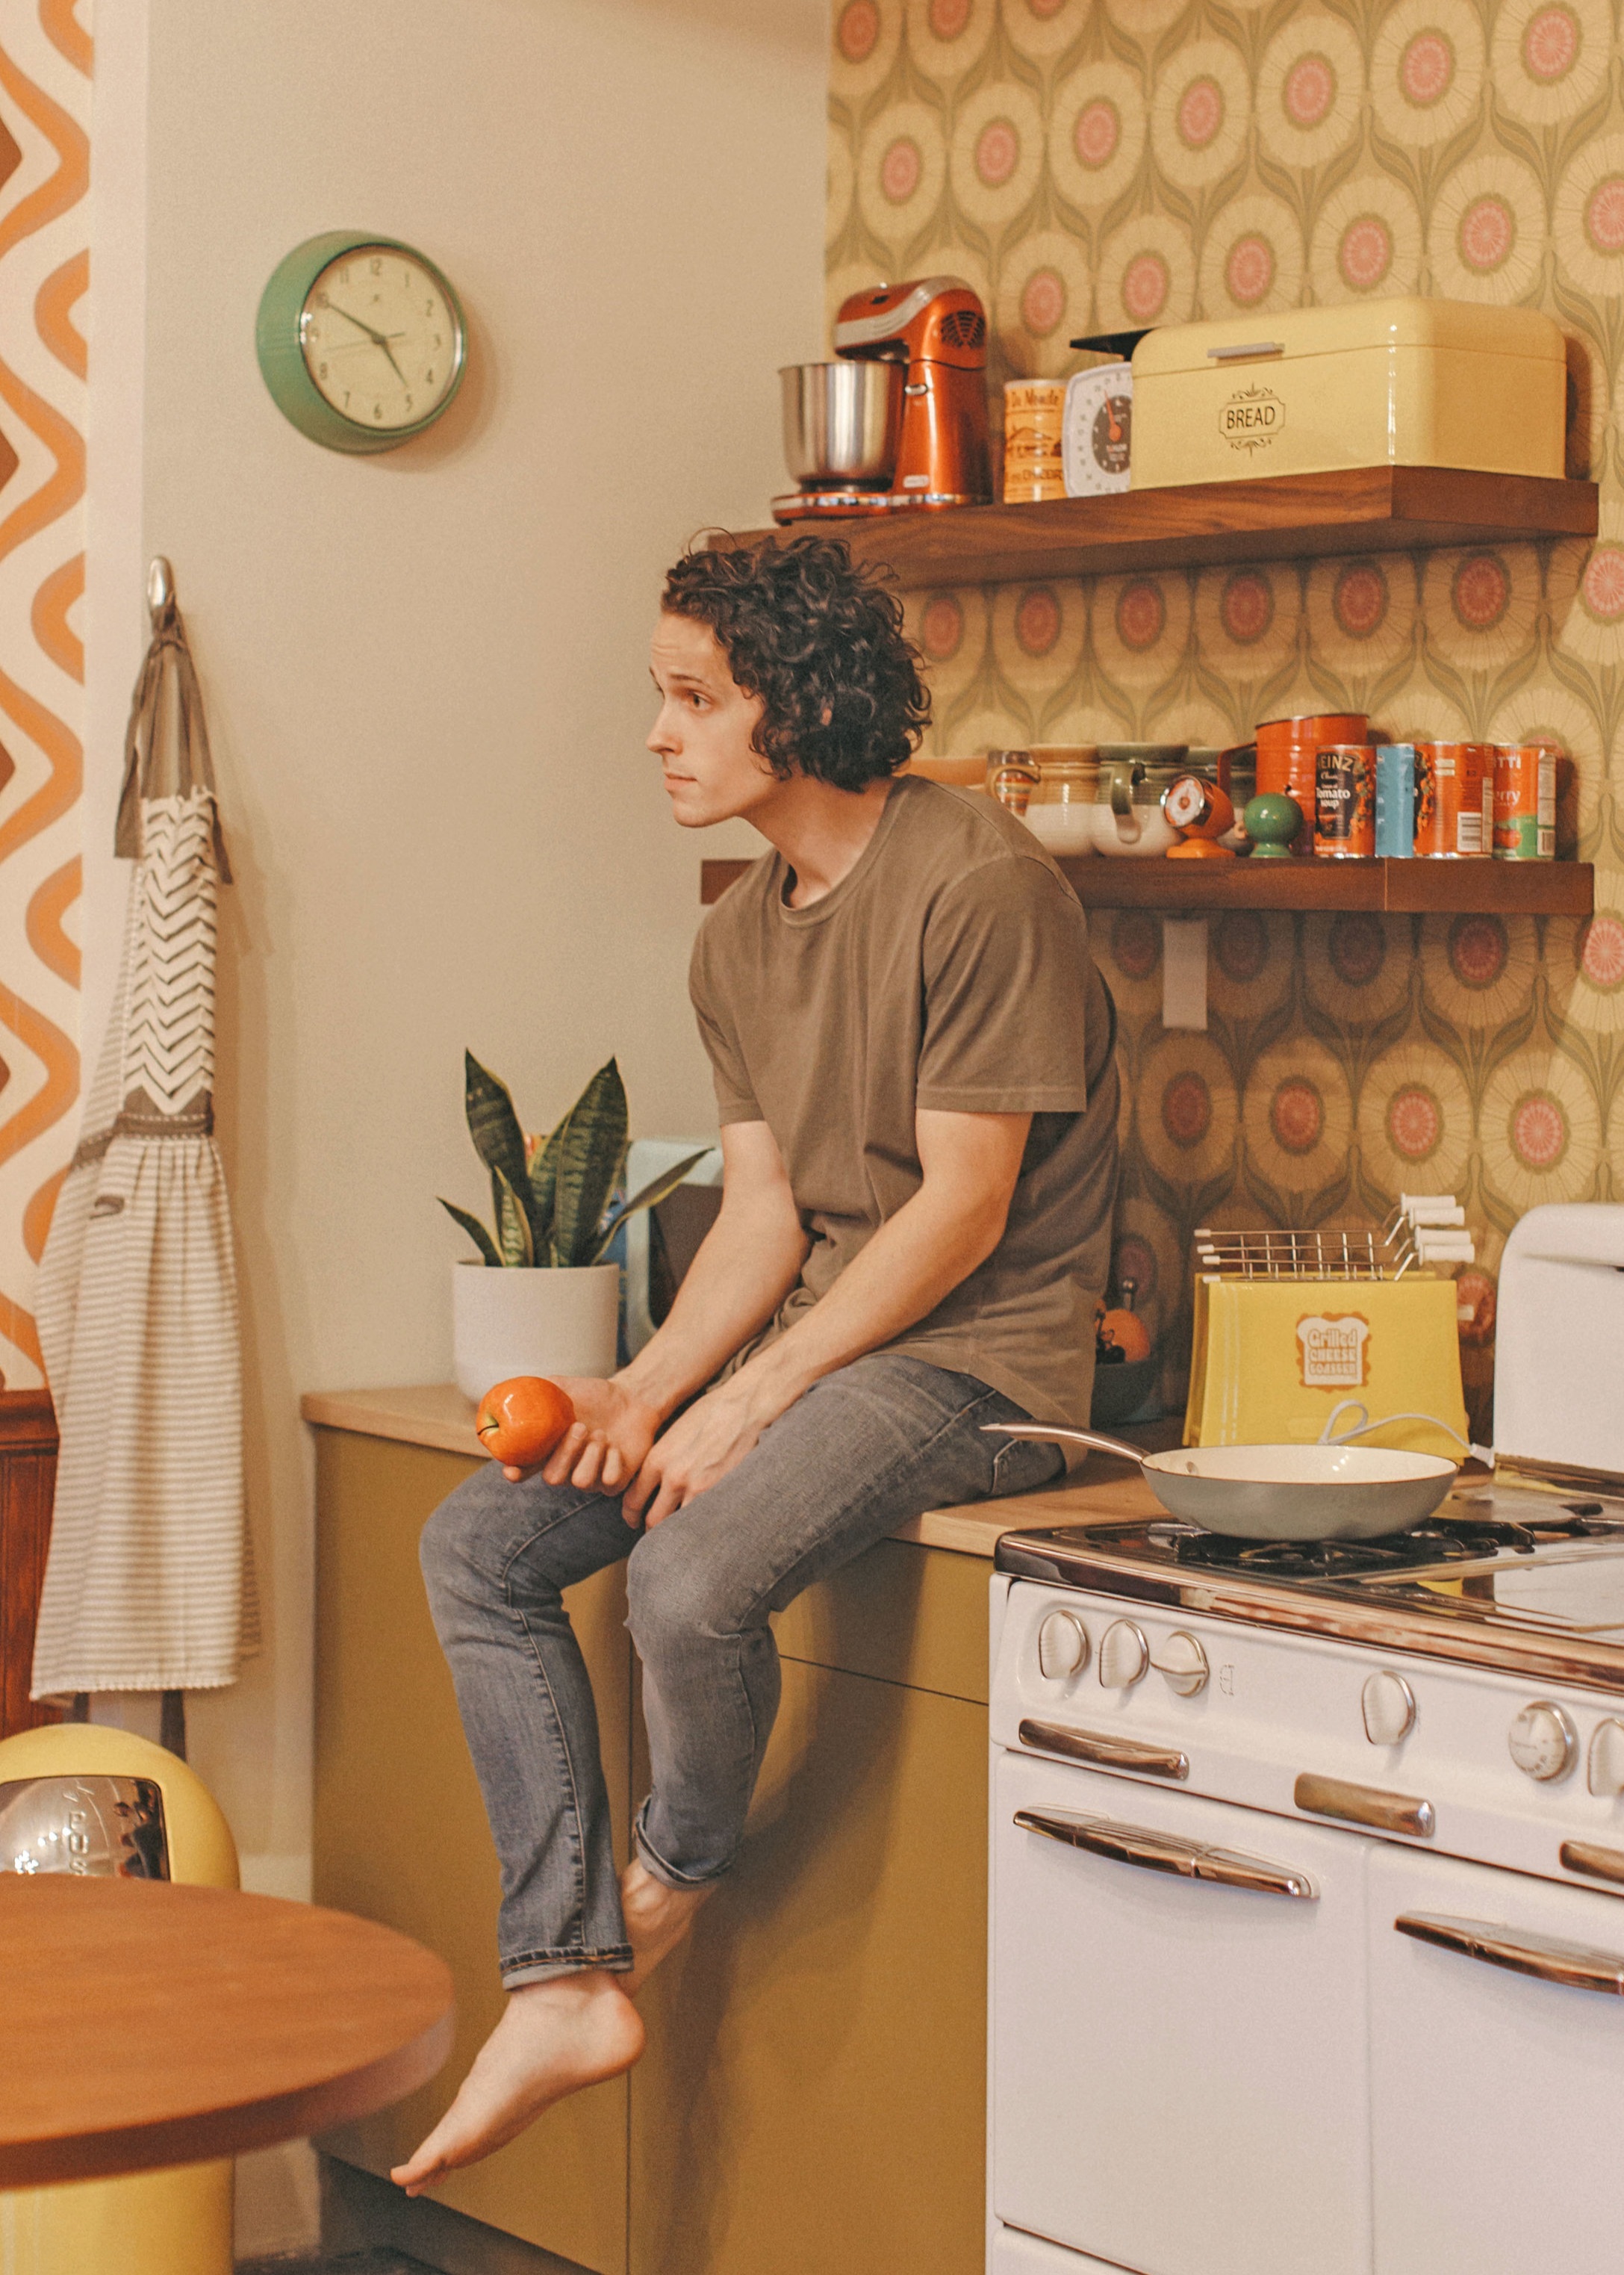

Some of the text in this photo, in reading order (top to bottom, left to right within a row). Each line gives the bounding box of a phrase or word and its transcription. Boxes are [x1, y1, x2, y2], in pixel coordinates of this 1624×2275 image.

[340, 266, 349, 284] 11
[370, 258, 382, 276] 12
[426, 299, 434, 317] 2
[426, 368, 434, 385] 4
[343, 390, 351, 409] 7
[374, 403, 382, 420] 6
[1226, 406, 1275, 429] BREAD
[1308, 1329, 1357, 1347] Grilled
[1310, 1347, 1356, 1362] CHEESE
[69, 1810, 89, 1875] PUS
